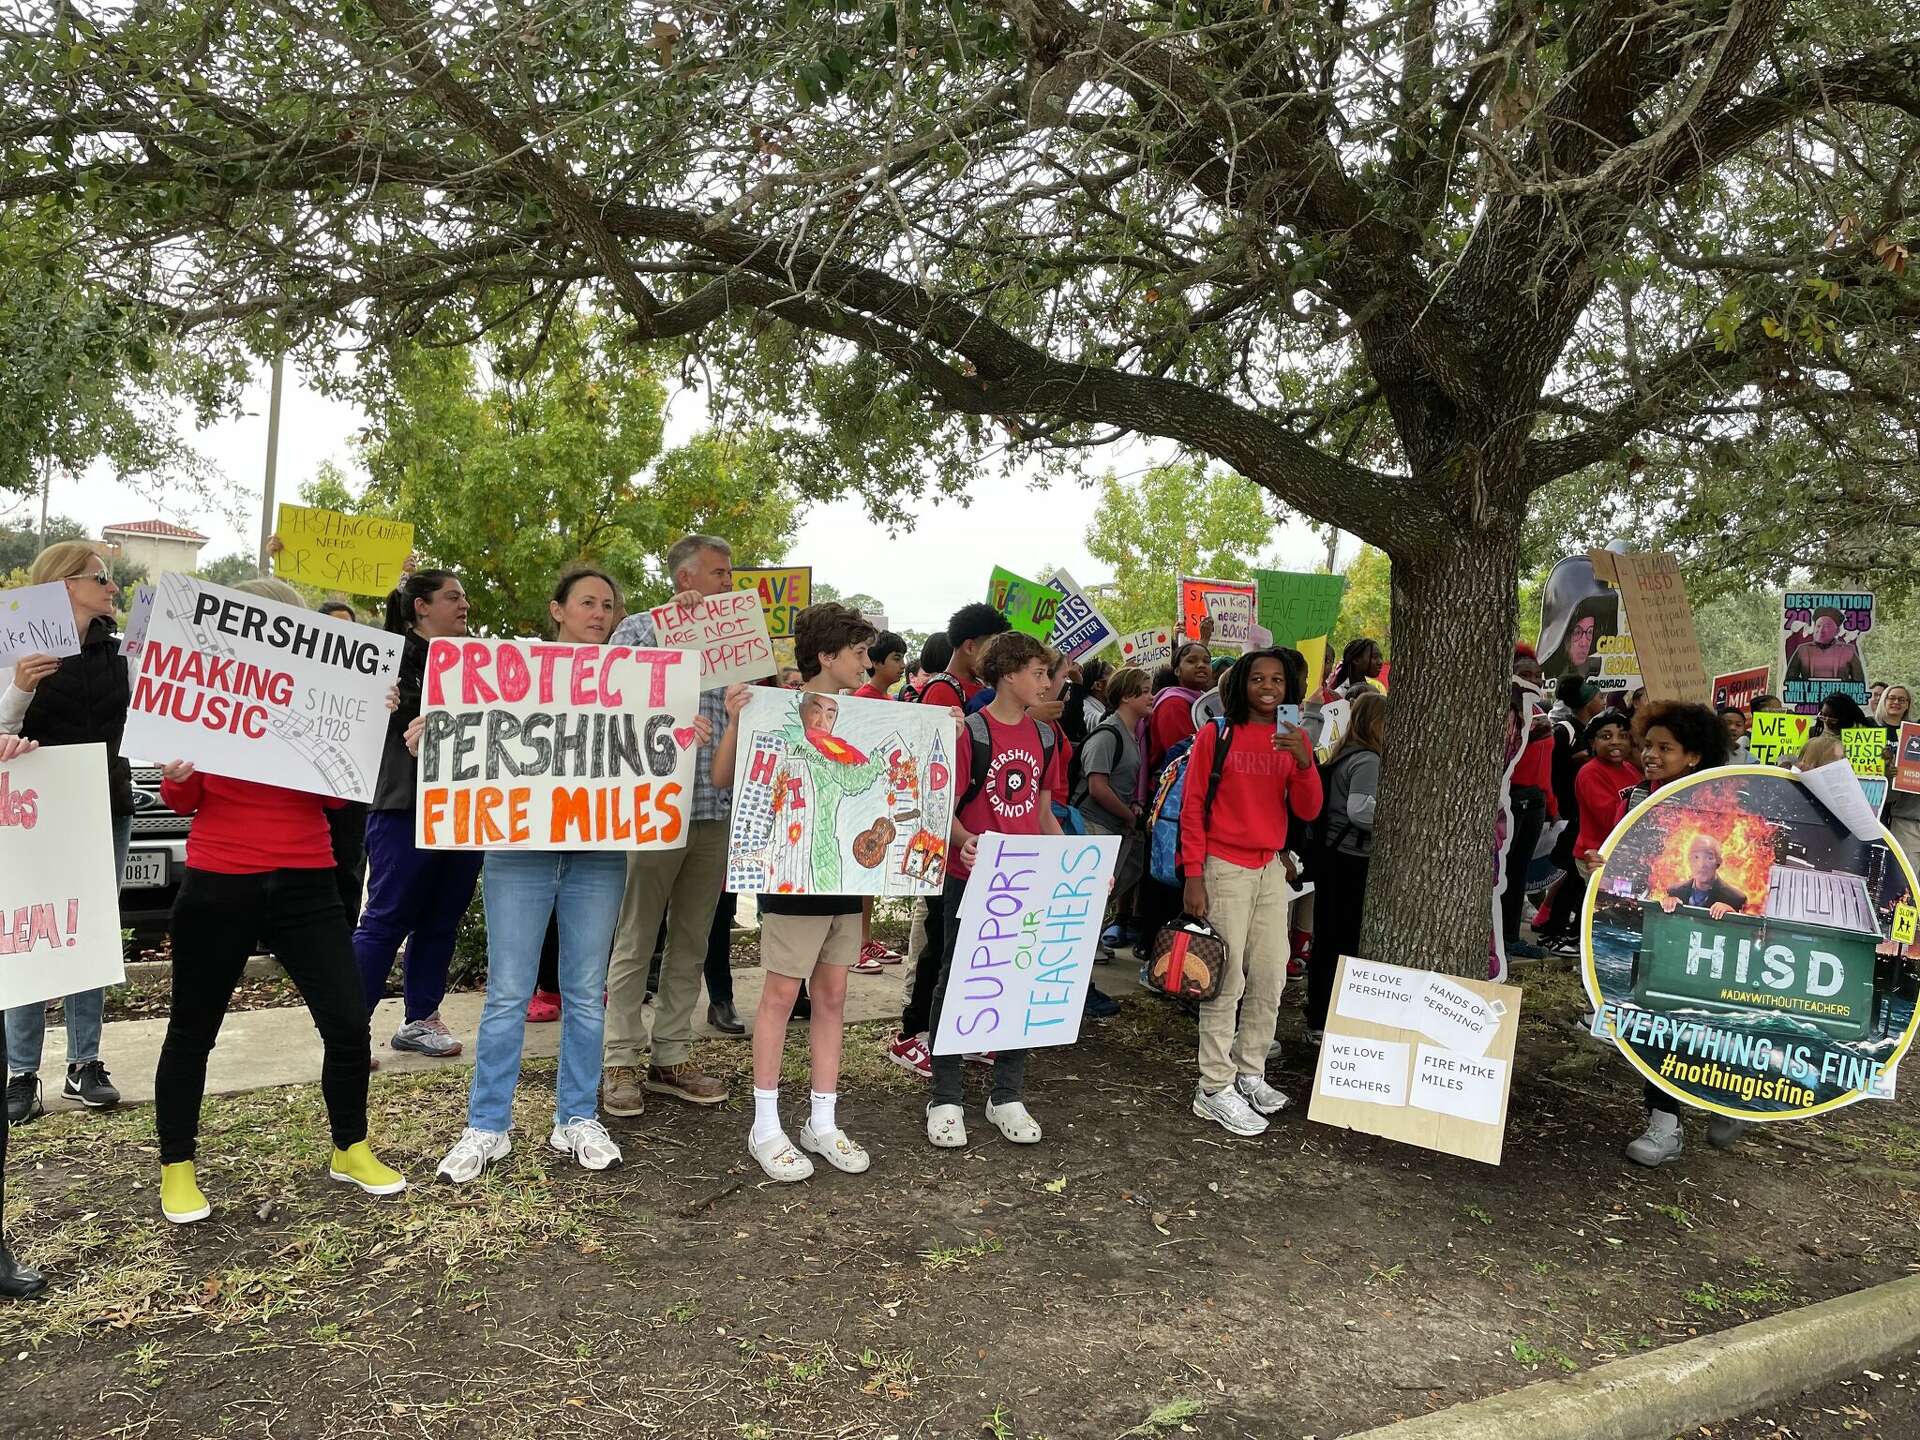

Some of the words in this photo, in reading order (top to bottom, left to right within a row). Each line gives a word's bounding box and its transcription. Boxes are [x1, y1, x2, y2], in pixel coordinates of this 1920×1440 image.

[277, 549, 311, 575] DR
[651, 595, 756, 630] TEACHERS
[1260, 596, 1301, 619] EAVE
[1785, 594, 1872, 609] DESTINATION
[193, 592, 380, 676] PERSHING
[664, 628, 698, 647] ARE
[704, 617, 750, 639] NOT
[1069, 620, 1100, 647] BETTER
[1135, 631, 1155, 649] LET
[700, 637, 769, 676] UPPETS
[141, 640, 294, 707] MAKING
[427, 639, 683, 708] PROTECT
[131, 677, 269, 739] MUSIC
[304, 687, 369, 723] SINCE
[313, 716, 352, 742] 1928
[1758, 718, 1786, 737] WE
[1843, 731, 1883, 744] SAVE
[422, 709, 678, 783] PERSHING
[1845, 744, 1883, 758] HISD
[987, 748, 1040, 779] PERSHING
[1848, 757, 1877, 765] ROM
[1852, 764, 1883, 773] IKE
[0, 770, 39, 830] les
[424, 786, 532, 845] FIRE
[550, 782, 683, 844] MILES
[125, 863, 160, 880] 0817
[0, 898, 79, 955] LEM!
[956, 840, 1040, 1037] SUPPORT
[1014, 909, 1045, 970] OUR
[1023, 844, 1102, 1036] TEACHERS
[1351, 968, 1369, 980] WE
[1372, 972, 1403, 986] LOVE
[1685, 930, 1845, 997] HISD
[1348, 983, 1412, 1003] PERSHING!
[1429, 983, 1470, 1008] HANDS
[1720, 988, 1851, 1017] #ADAYWITHOUTTEACHERS
[1423, 995, 1483, 1034] PERSHING!
[1332, 1044, 1350, 1056] WE
[1354, 1047, 1385, 1061] LOVE
[1596, 1004, 1772, 1072] EVERYTHING
[1782, 1043, 1813, 1078] IS
[1330, 1060, 1356, 1072] OUR
[1424, 1055, 1455, 1072] FIRE
[1459, 1063, 1496, 1080] MIKE
[1659, 1053, 1815, 1108] #nothingisfine
[1329, 1075, 1392, 1094] TEACHERS
[1421, 1073, 1464, 1091] MILES
